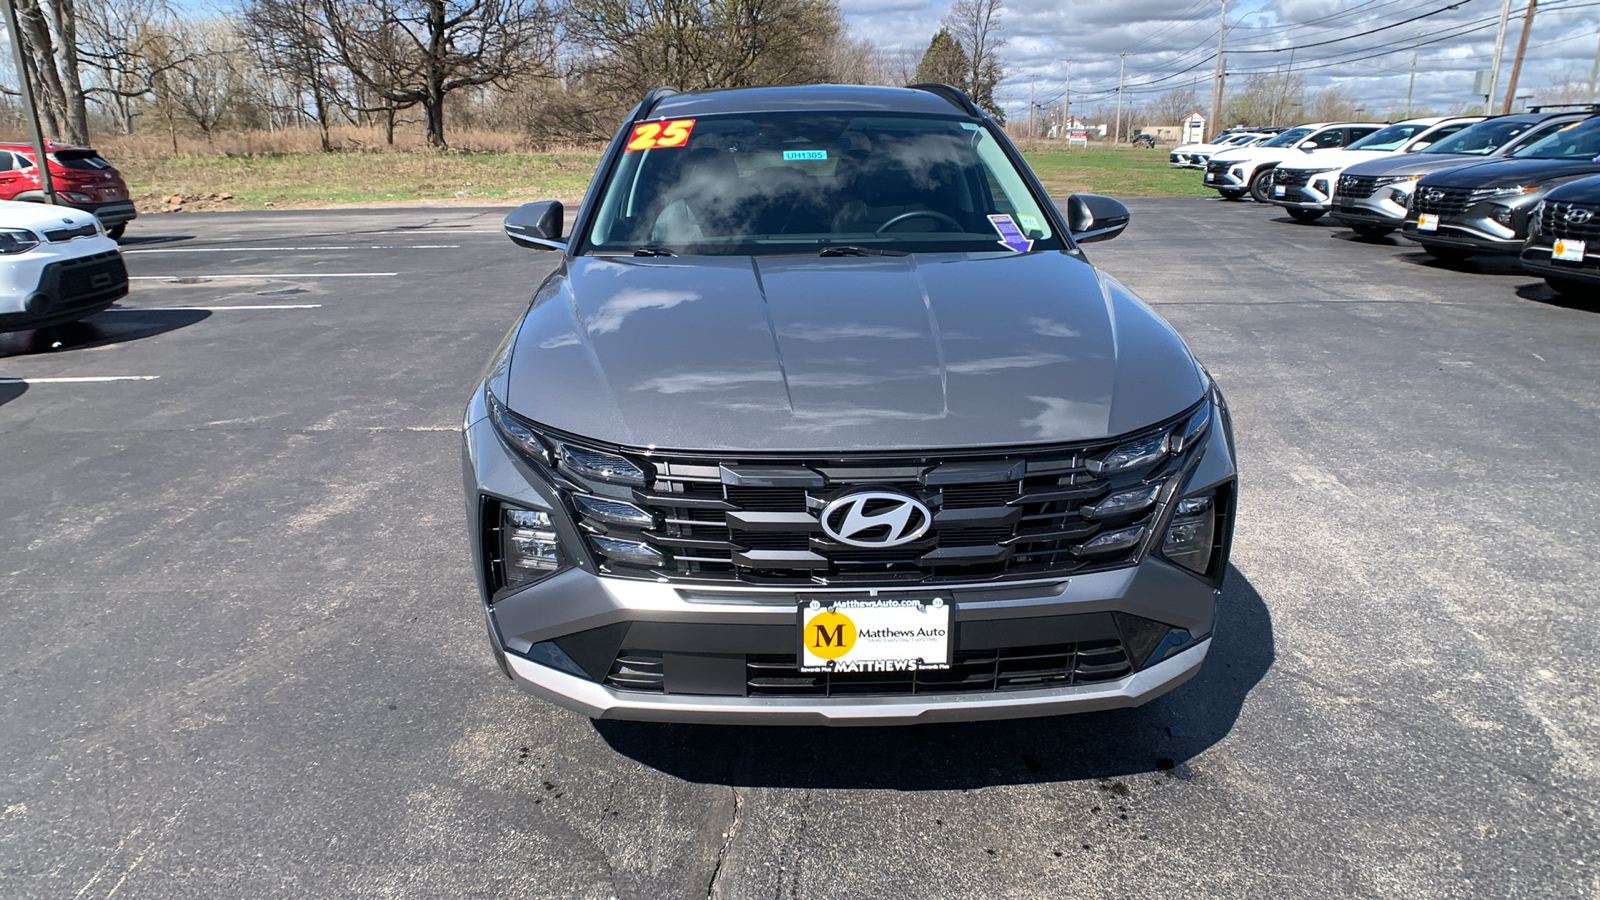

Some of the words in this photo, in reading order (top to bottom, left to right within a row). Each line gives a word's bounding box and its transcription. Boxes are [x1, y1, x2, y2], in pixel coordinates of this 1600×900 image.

[628, 119, 694, 150] 25
[786, 151, 823, 159] UH1305
[833, 599, 920, 608] MatthewsAuto.com
[812, 624, 847, 647] M
[858, 627, 914, 638] Matthews
[916, 627, 946, 637] Auto
[834, 659, 917, 672] MATTHEWS
